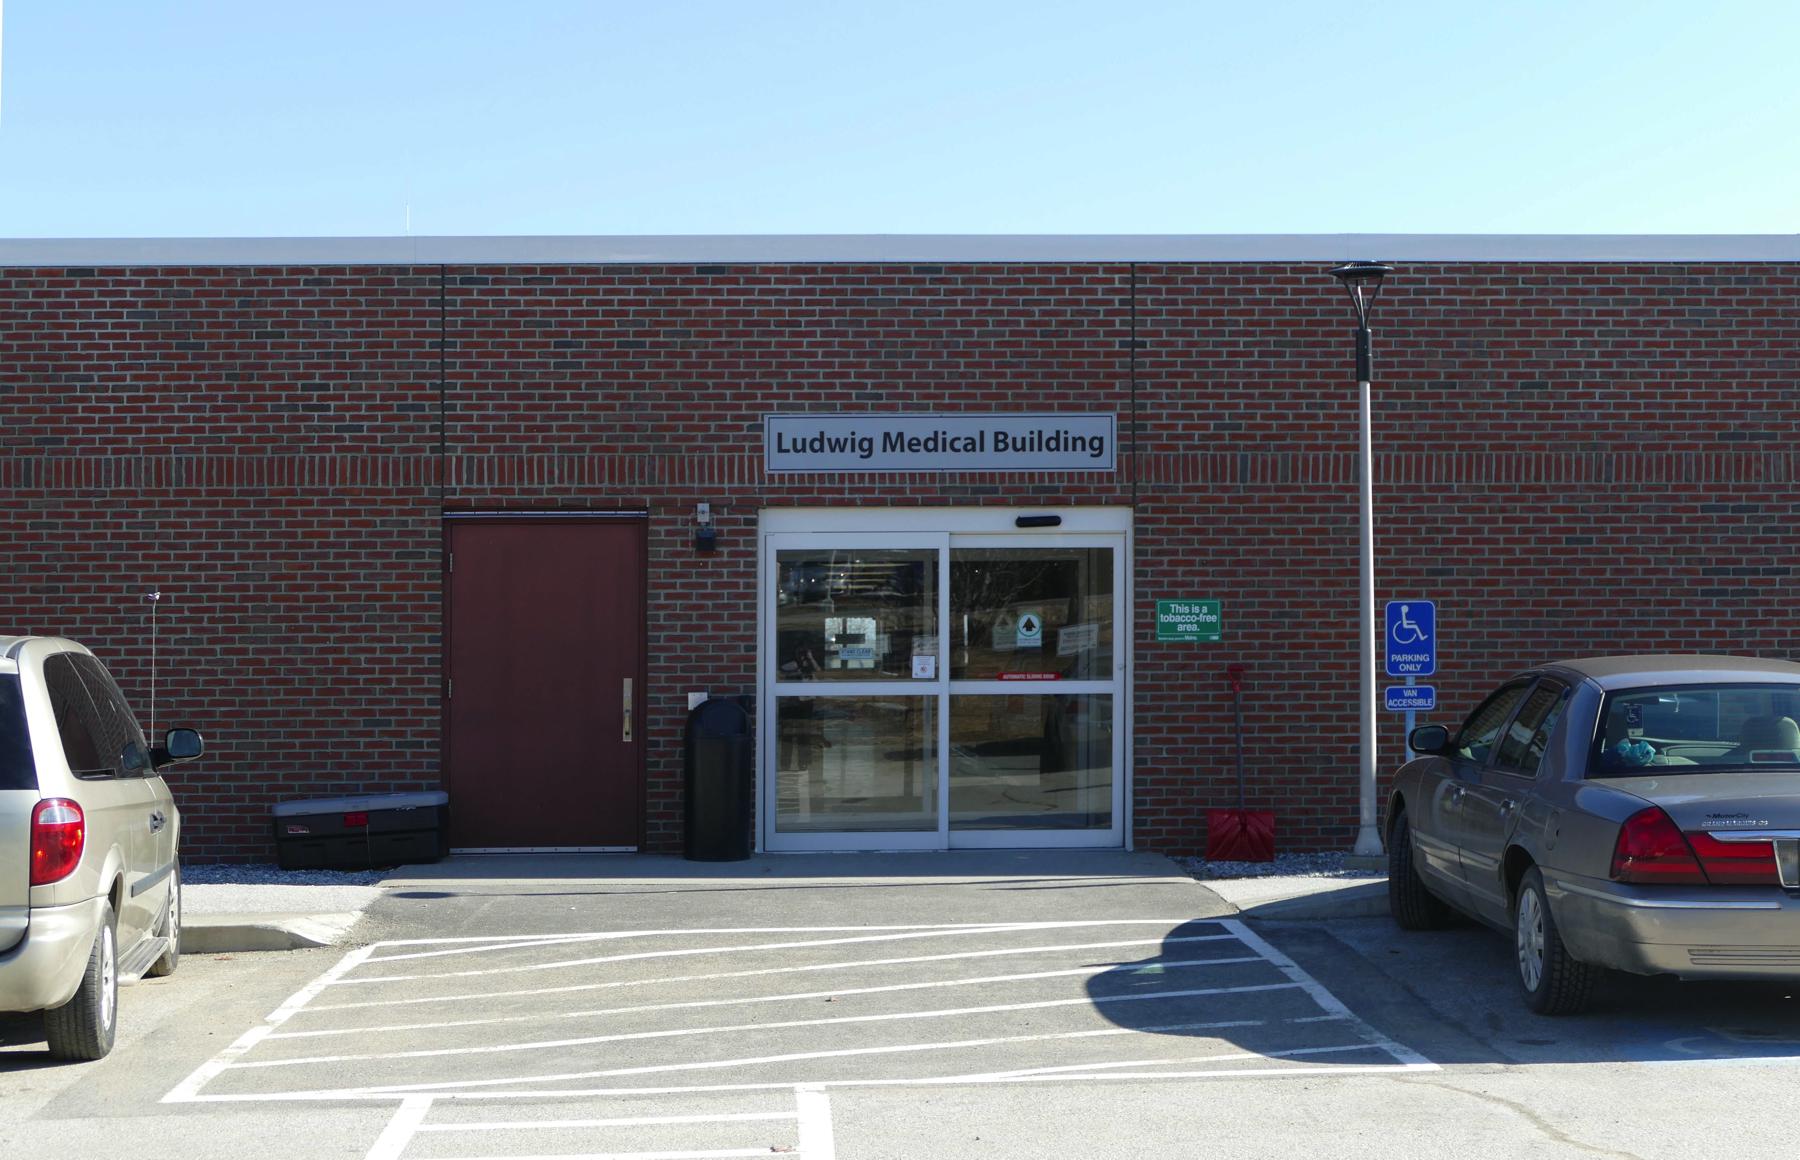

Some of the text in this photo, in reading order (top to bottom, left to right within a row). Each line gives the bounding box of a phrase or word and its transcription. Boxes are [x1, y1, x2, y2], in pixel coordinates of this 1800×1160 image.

[777, 430, 1105, 459] Ludwig Medical Building
[1169, 604, 1189, 613] This
[1191, 604, 1200, 613] is
[1160, 613, 1217, 622] tobacco-free
[1391, 654, 1430, 662] PARKING
[1399, 663, 1422, 671] ONLY
[1403, 689, 1417, 697] VAN
[1388, 698, 1433, 707] ACCESSIBLE
